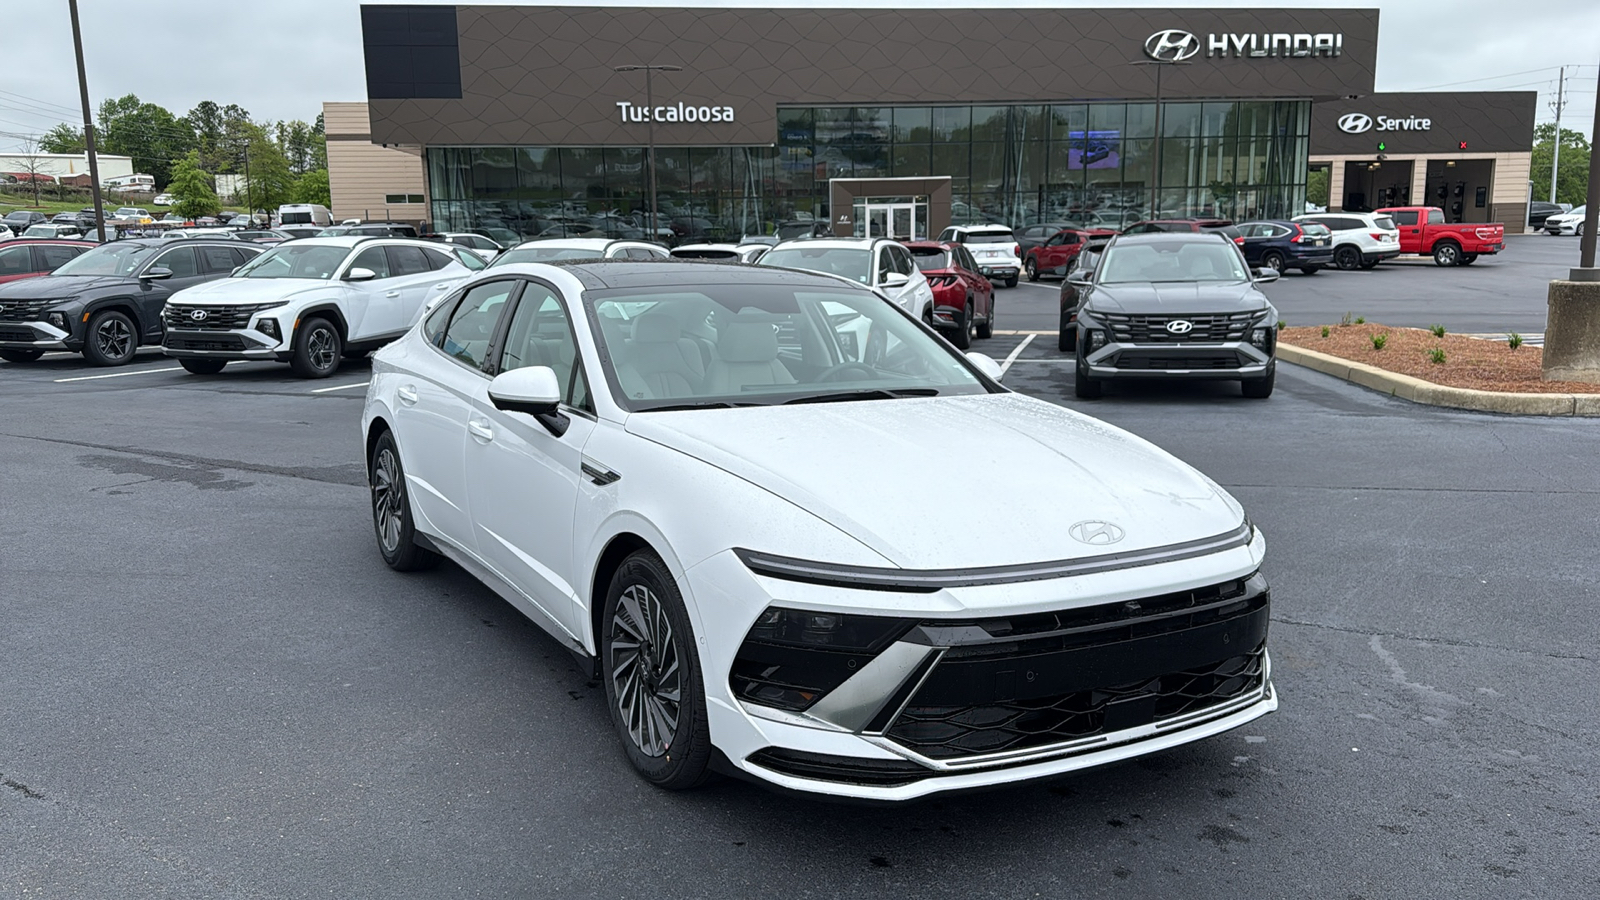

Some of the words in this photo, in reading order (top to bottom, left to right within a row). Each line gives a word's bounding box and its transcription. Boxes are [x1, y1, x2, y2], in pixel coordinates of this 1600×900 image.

[1208, 33, 1343, 57] HYUNDAI
[616, 101, 734, 122] Tuscaloosa
[1376, 115, 1432, 131] Service
